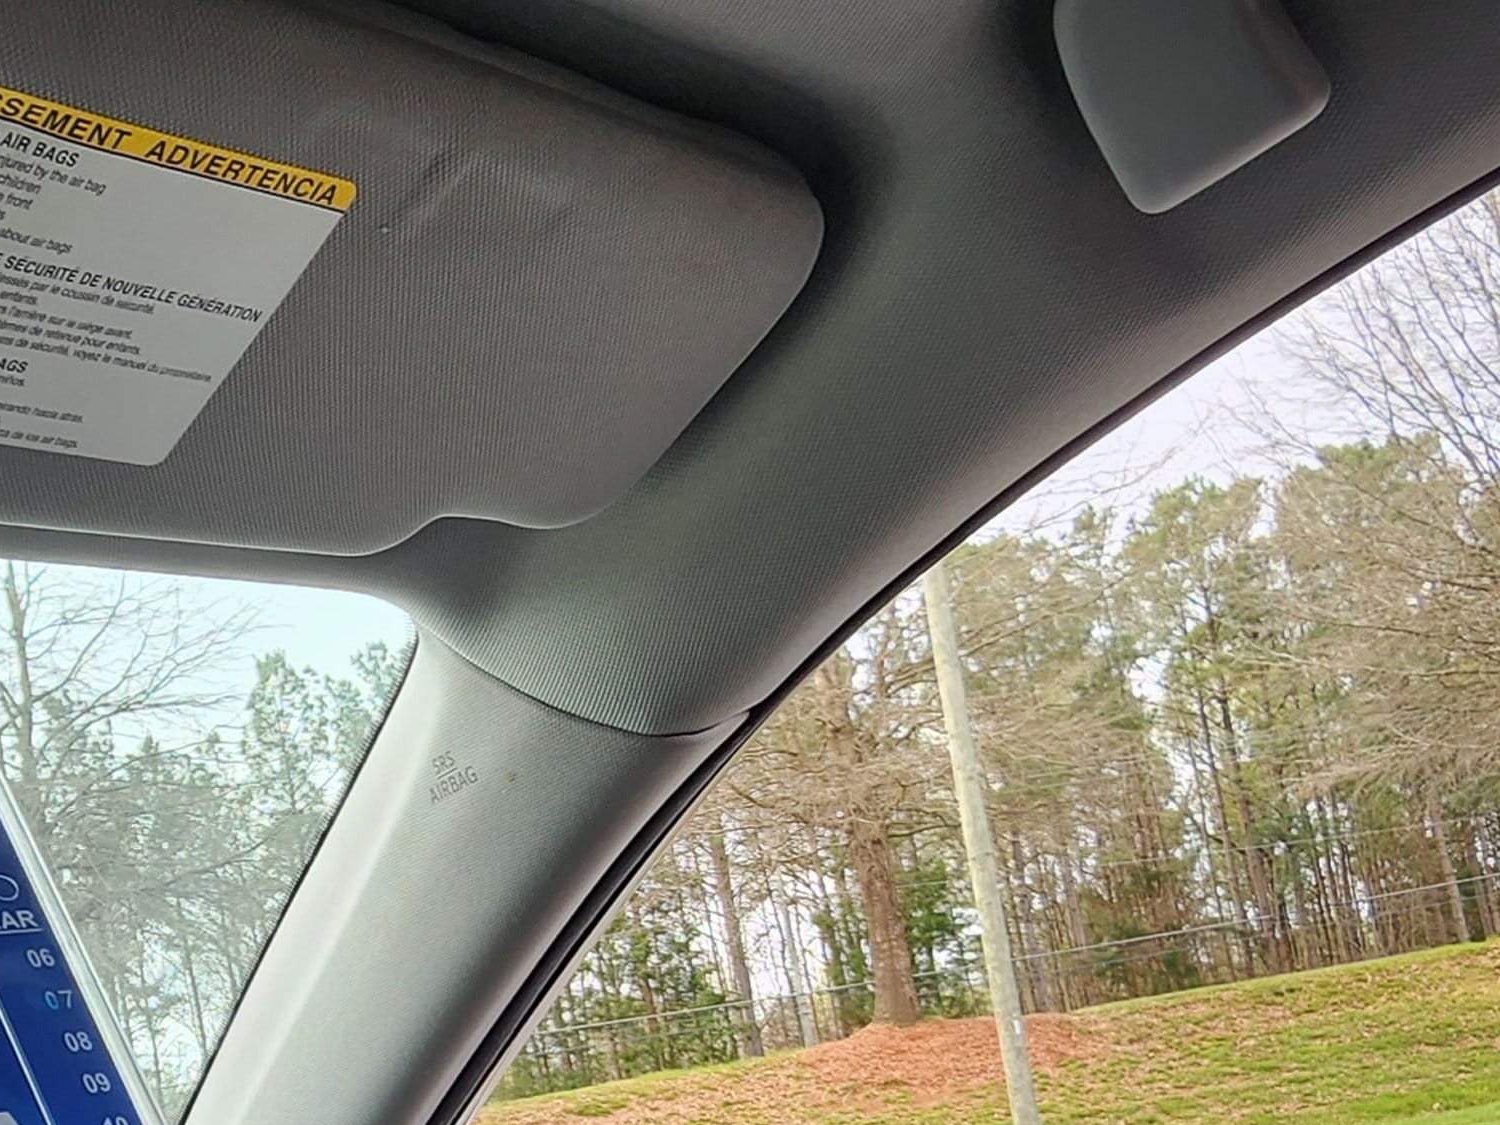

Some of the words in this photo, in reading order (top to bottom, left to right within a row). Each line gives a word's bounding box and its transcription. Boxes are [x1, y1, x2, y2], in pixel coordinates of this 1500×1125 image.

[0, 129, 31, 152] AIR
[33, 139, 80, 167] BAGS
[32, 163, 49, 182] by
[49, 168, 69, 184] the
[68, 173, 85, 188] air
[82, 178, 107, 197] bag
[146, 141, 338, 206] ADVERTENCIA
[5, 192, 33, 210] front
[5, 250, 80, 283] SÉCURITÉ
[79, 271, 101, 288] DE
[101, 276, 176, 304] NOUVELLE
[176, 290, 263, 322] GÉNÉRATION
[431, 751, 456, 775] SRS
[430, 765, 478, 804] AIRBAG
[27, 948, 55, 968] 06
[45, 990, 72, 1010] 07
[64, 1032, 93, 1052] 08
[83, 1073, 111, 1094] 09
